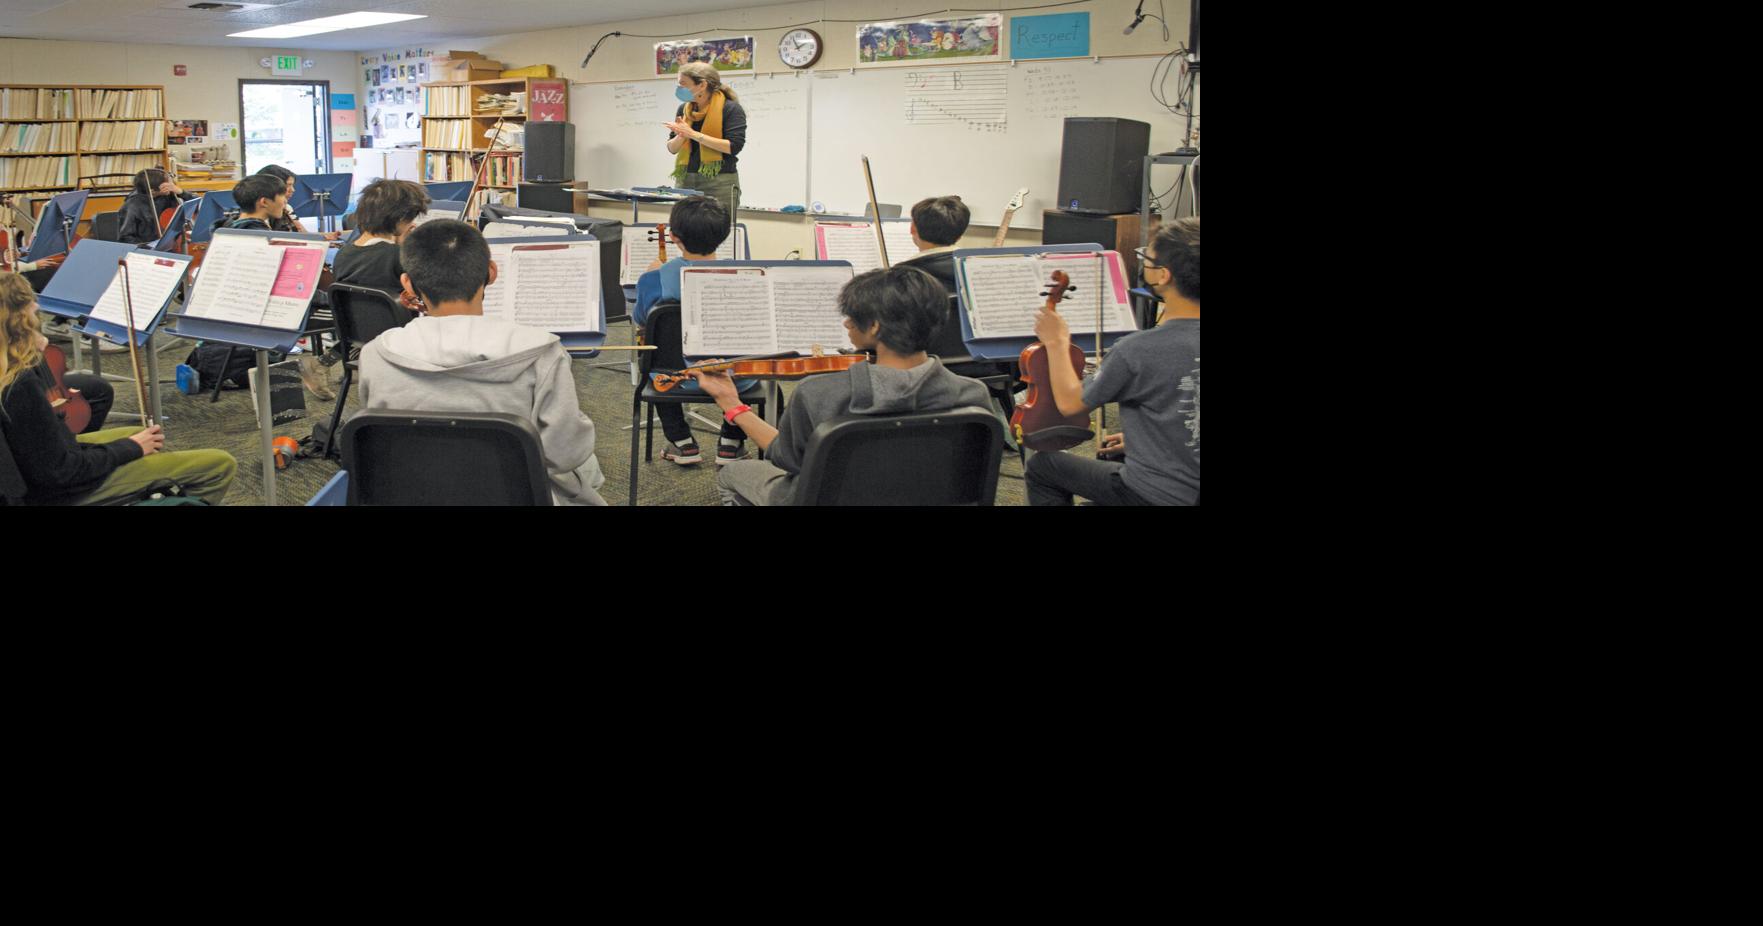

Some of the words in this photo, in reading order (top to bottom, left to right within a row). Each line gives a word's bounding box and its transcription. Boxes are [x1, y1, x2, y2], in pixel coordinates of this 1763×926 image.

[1017, 19, 1080, 48] Respect
[405, 47, 434, 59] Matters
[278, 56, 297, 70] EXIT
[953, 71, 964, 90] B
[532, 90, 565, 104] JAZZ
